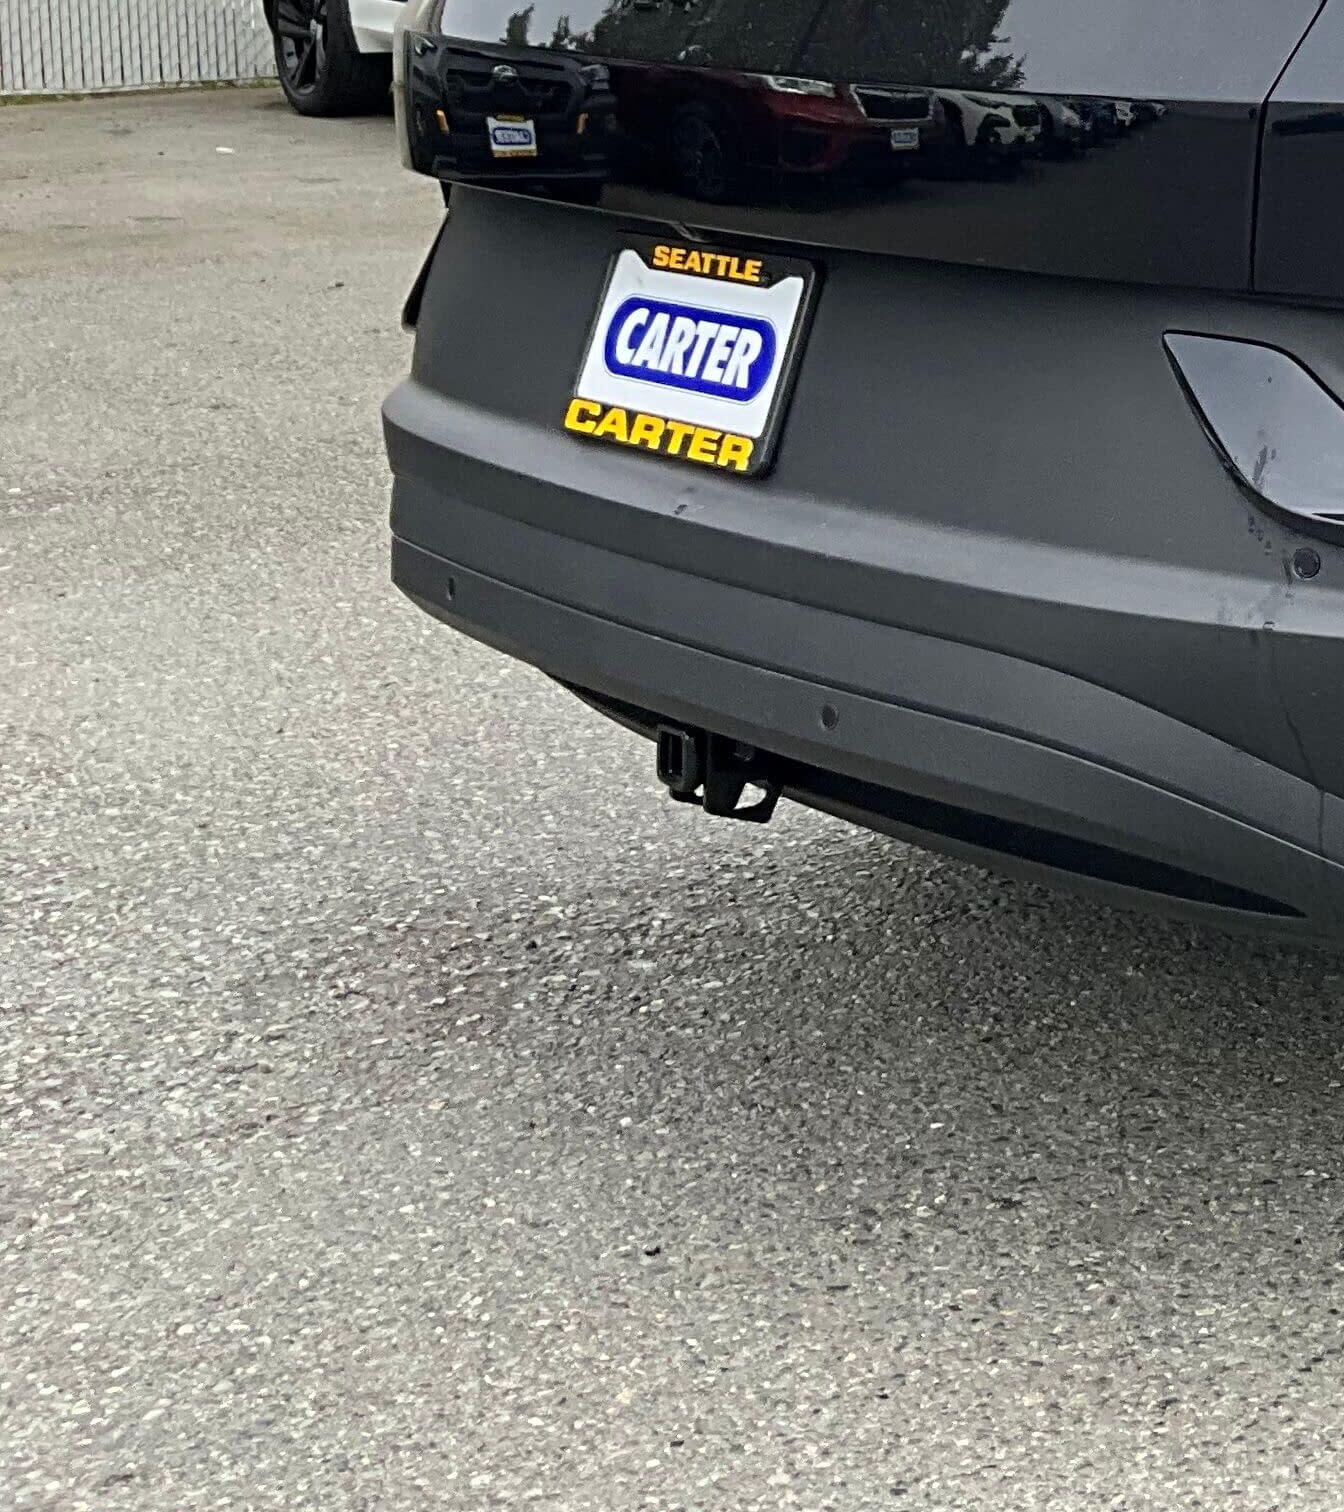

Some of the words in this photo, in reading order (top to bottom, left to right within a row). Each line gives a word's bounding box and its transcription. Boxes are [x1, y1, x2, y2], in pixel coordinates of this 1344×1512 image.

[653, 245, 762, 283] SEATTLE
[615, 307, 762, 389] CARTER
[564, 398, 754, 471] CARTER
